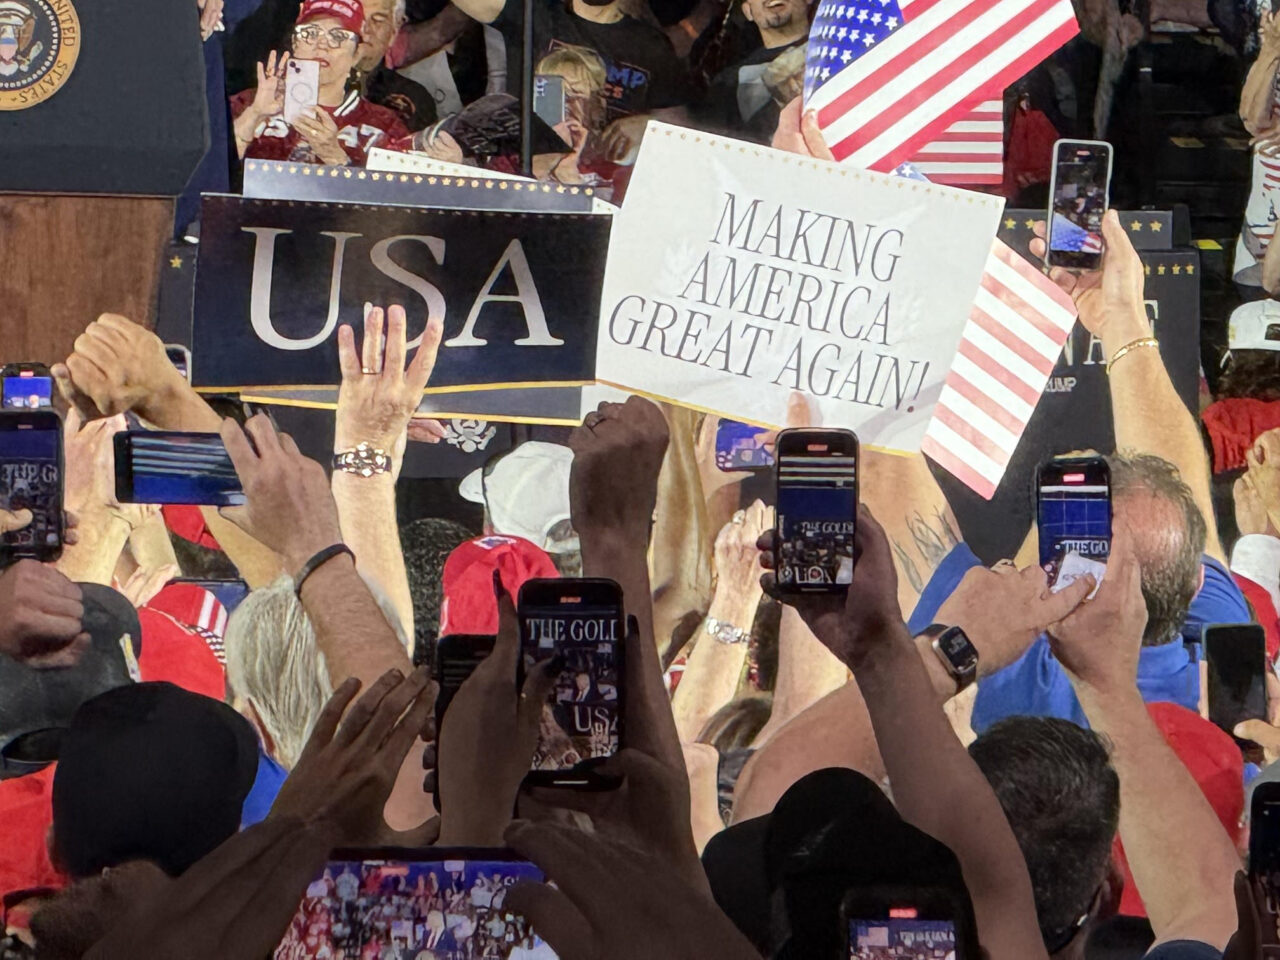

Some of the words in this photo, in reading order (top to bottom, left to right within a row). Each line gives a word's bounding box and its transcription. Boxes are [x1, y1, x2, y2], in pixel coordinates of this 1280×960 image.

[19, 60, 68, 103] STATES
[709, 192, 904, 282] MAKING
[241, 226, 565, 352] USA
[677, 250, 891, 346] AMERICA
[608, 294, 774, 378] GREAT
[771, 336, 930, 413] AGAIN!
[526, 618, 566, 641] THE
